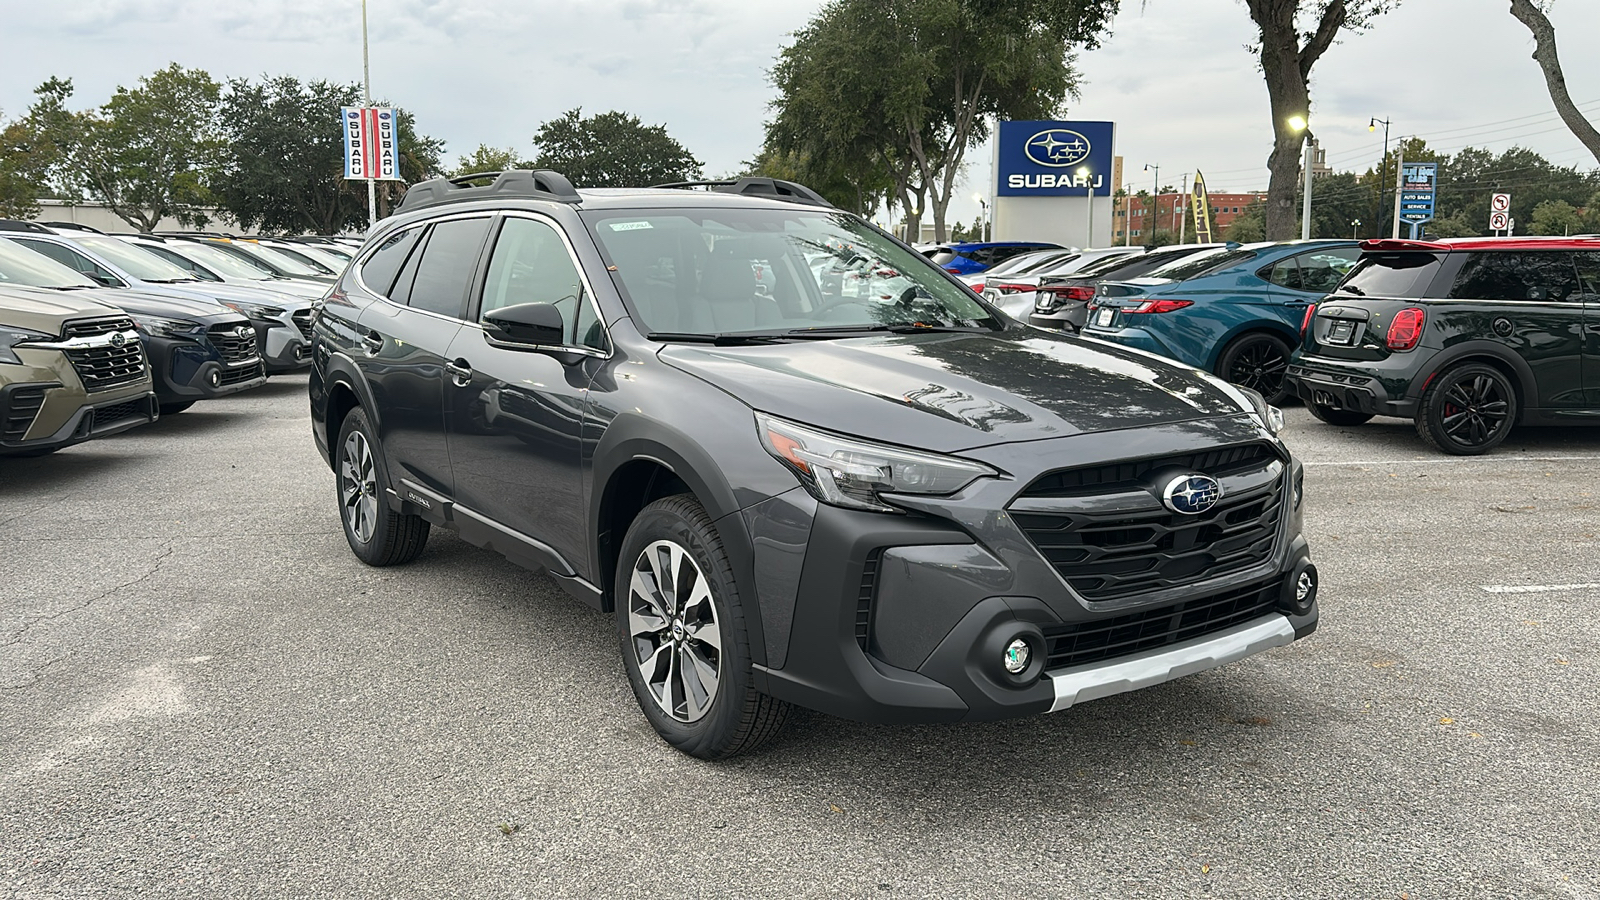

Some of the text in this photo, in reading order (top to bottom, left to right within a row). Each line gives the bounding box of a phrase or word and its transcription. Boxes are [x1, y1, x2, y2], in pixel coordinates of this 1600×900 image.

[349, 121, 361, 175] SUBARU
[381, 122, 393, 175] SUBARU
[1008, 174, 1103, 188] SUBARU
[678, 529, 713, 574] AVID
